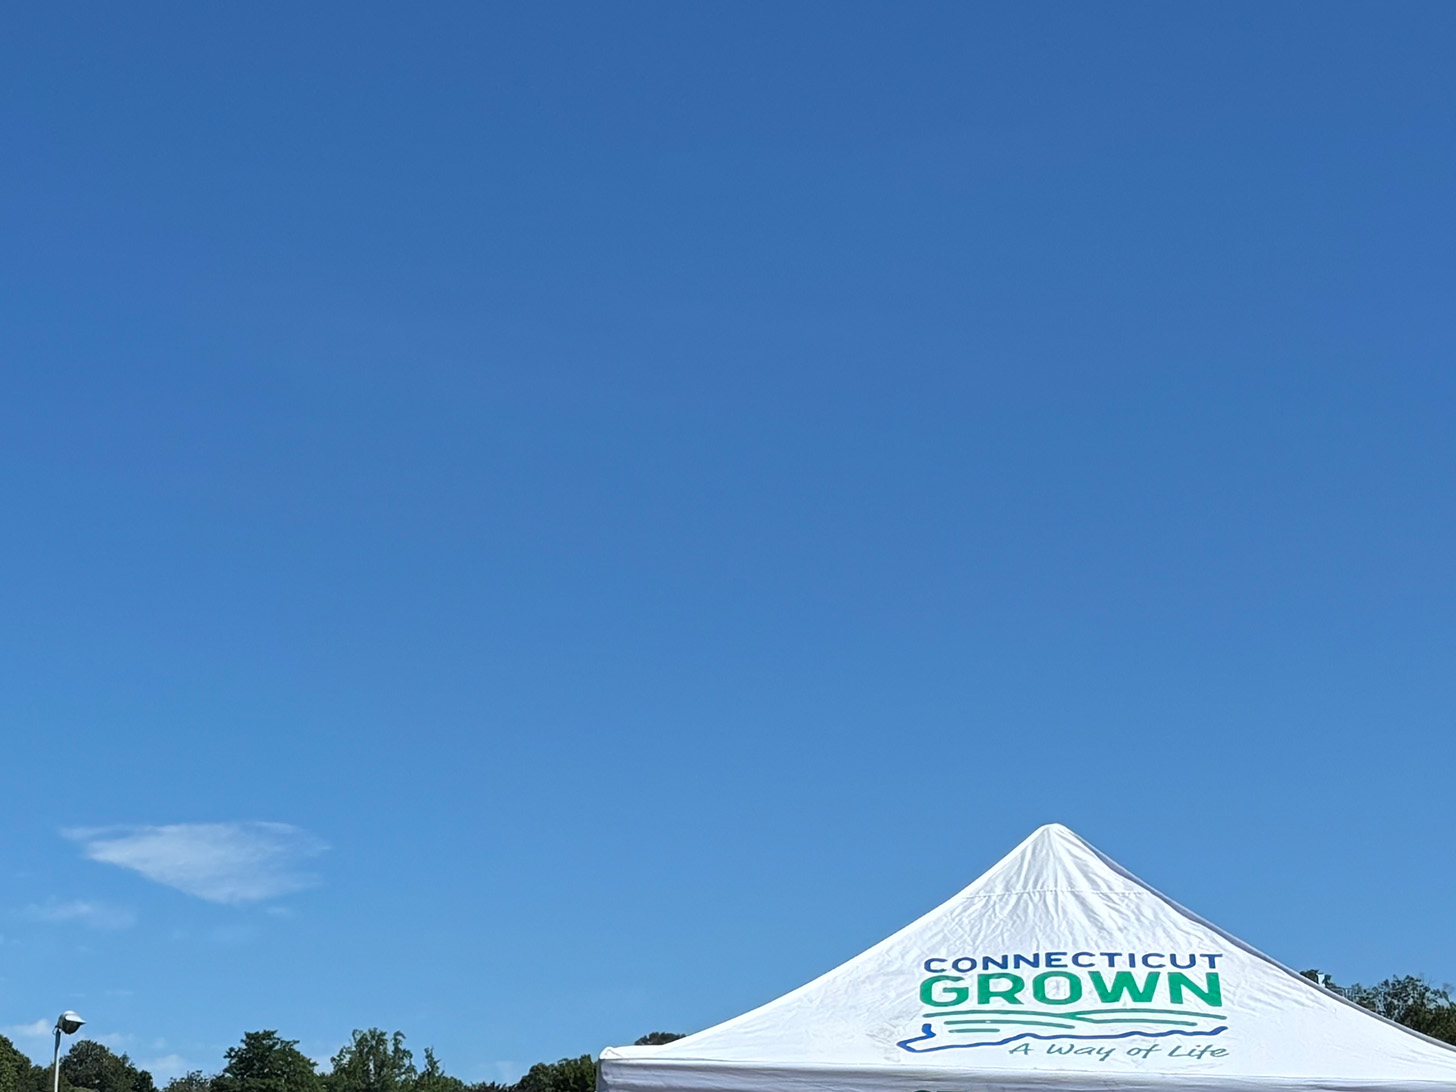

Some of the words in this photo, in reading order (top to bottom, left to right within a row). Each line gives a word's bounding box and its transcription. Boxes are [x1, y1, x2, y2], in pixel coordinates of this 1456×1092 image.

[924, 952, 1223, 973] CONNECTICUT
[919, 971, 1222, 1007] GROWN
[1008, 1042, 1030, 1055] A
[1046, 1043, 1116, 1061] Way
[1126, 1043, 1161, 1059] of
[1166, 1044, 1230, 1059] Life
